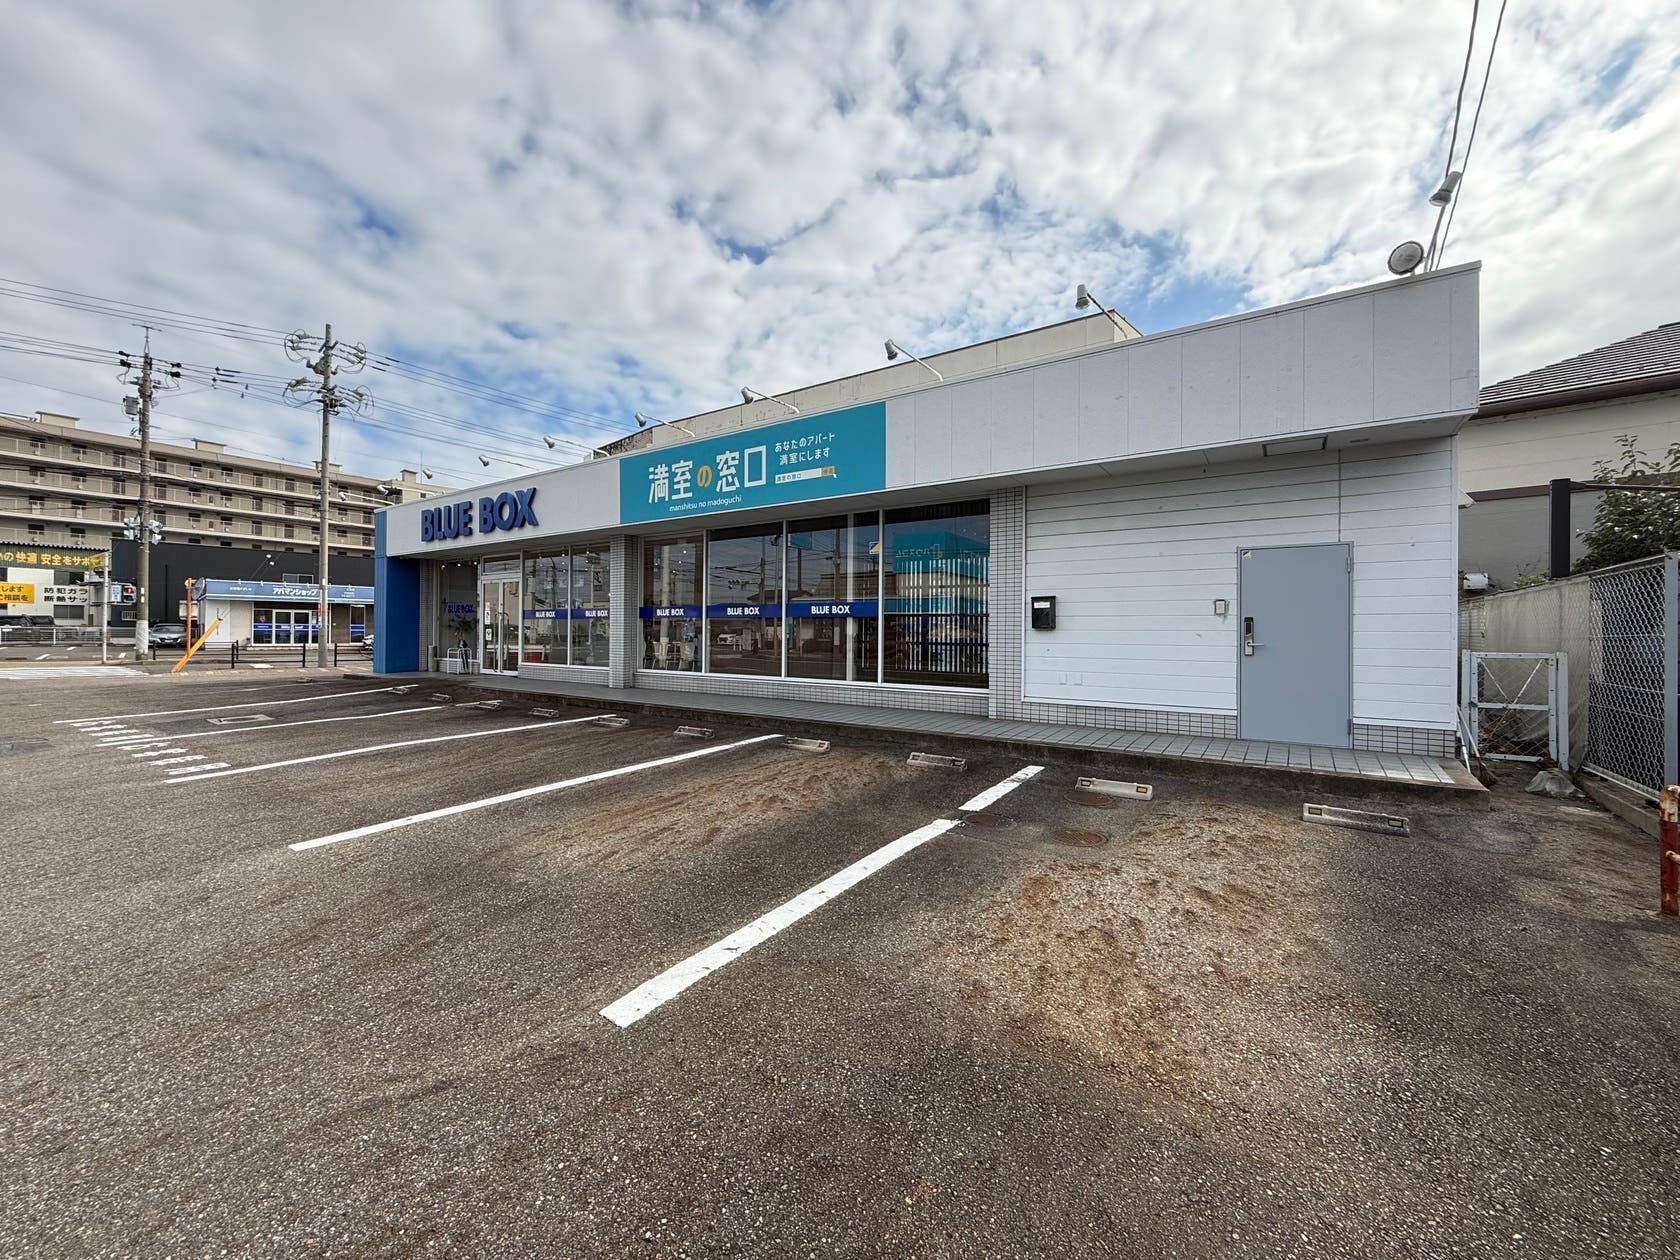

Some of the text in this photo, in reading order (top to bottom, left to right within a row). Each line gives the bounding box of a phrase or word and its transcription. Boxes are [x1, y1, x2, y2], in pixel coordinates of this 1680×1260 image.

[774, 432, 835, 453] あなたのアパート
[779, 447, 830, 466] 満室にします
[648, 445, 767, 504] 満室の窓口
[669, 495, 742, 512] manshitsu no madoguchi
[421, 487, 539, 542] BLUE BOX
[272, 587, 318, 596] アパマンショップ
[447, 603, 474, 613] BLUE BOX
[656, 608, 684, 616] BLUE BOX
[727, 607, 760, 615] BLUE BOX
[811, 605, 850, 614] BLUE BOX
[535, 610, 556, 618] BLUE BOX
